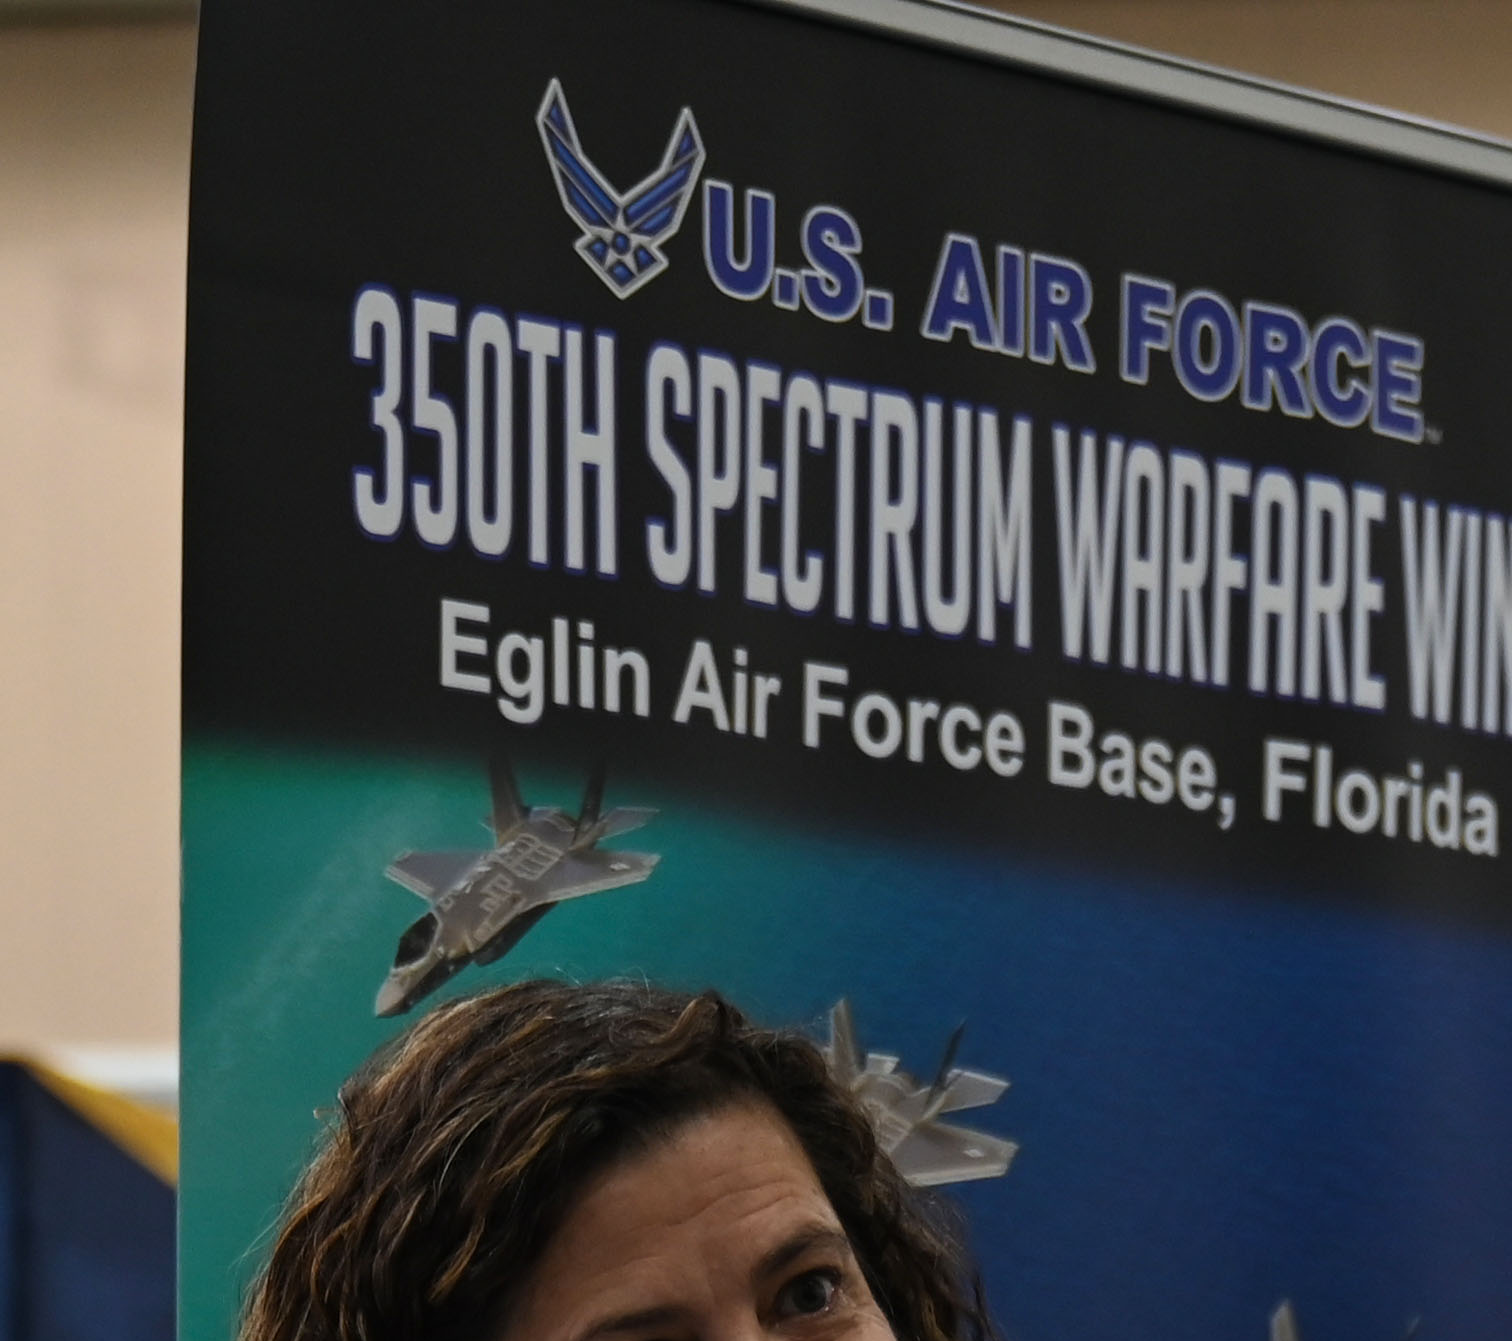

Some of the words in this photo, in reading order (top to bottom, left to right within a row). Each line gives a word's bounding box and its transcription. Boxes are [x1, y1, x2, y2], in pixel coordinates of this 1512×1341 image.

[703, 179, 890, 330] U.S.
[922, 235, 1094, 371] AIR
[1120, 274, 1426, 441] FORCE
[353, 283, 618, 577] 350TH
[647, 345, 1033, 649] SPECTRUM
[1054, 424, 1387, 711] WARFARE
[440, 599, 651, 723] Eglin
[675, 644, 779, 739] Air
[803, 668, 1024, 775] Force
[1048, 702, 1233, 828] Base,
[1263, 741, 1500, 855] Florida
